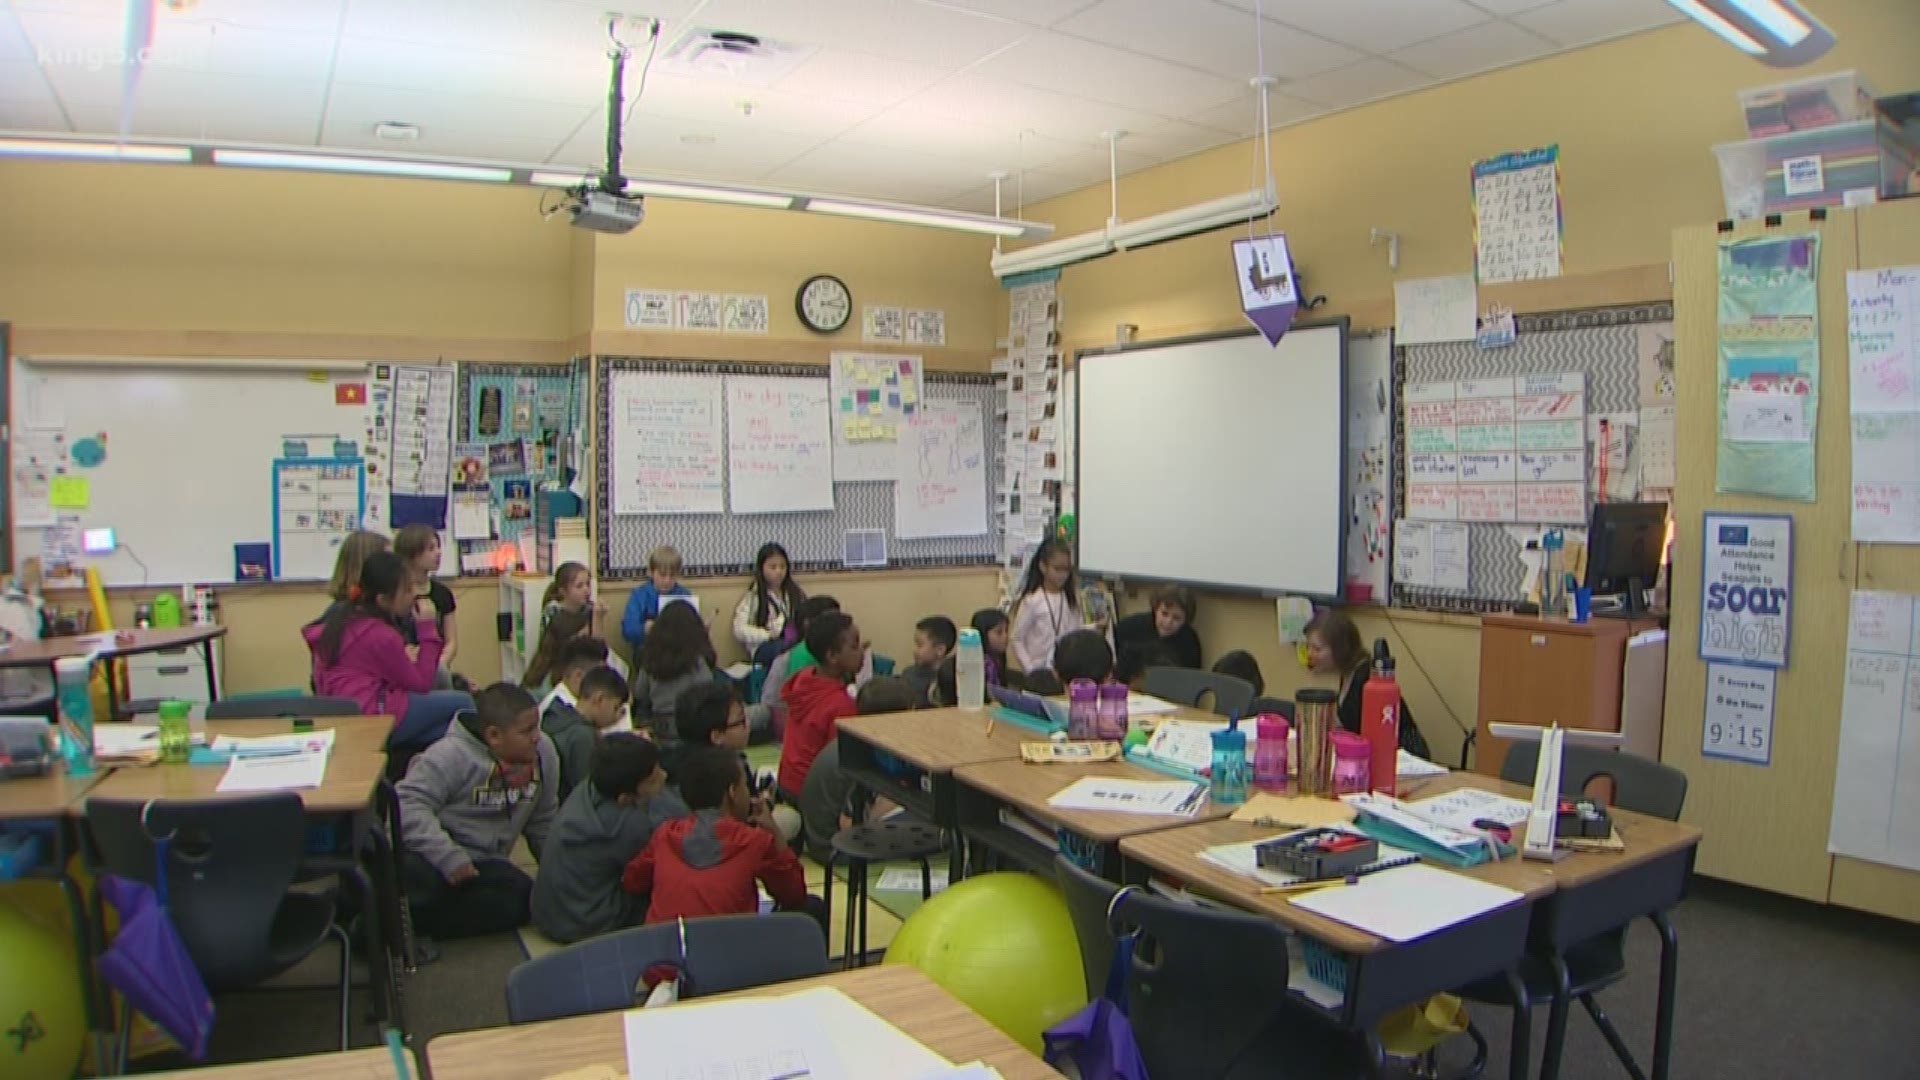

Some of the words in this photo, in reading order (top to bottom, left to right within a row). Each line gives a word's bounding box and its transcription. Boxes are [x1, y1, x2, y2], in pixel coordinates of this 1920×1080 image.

[1750, 537, 1776, 548] Good
[1720, 548, 1775, 560] Attendance
[1734, 561, 1761, 572] Helps
[1707, 582, 1787, 616] soar
[1704, 612, 1784, 660] high
